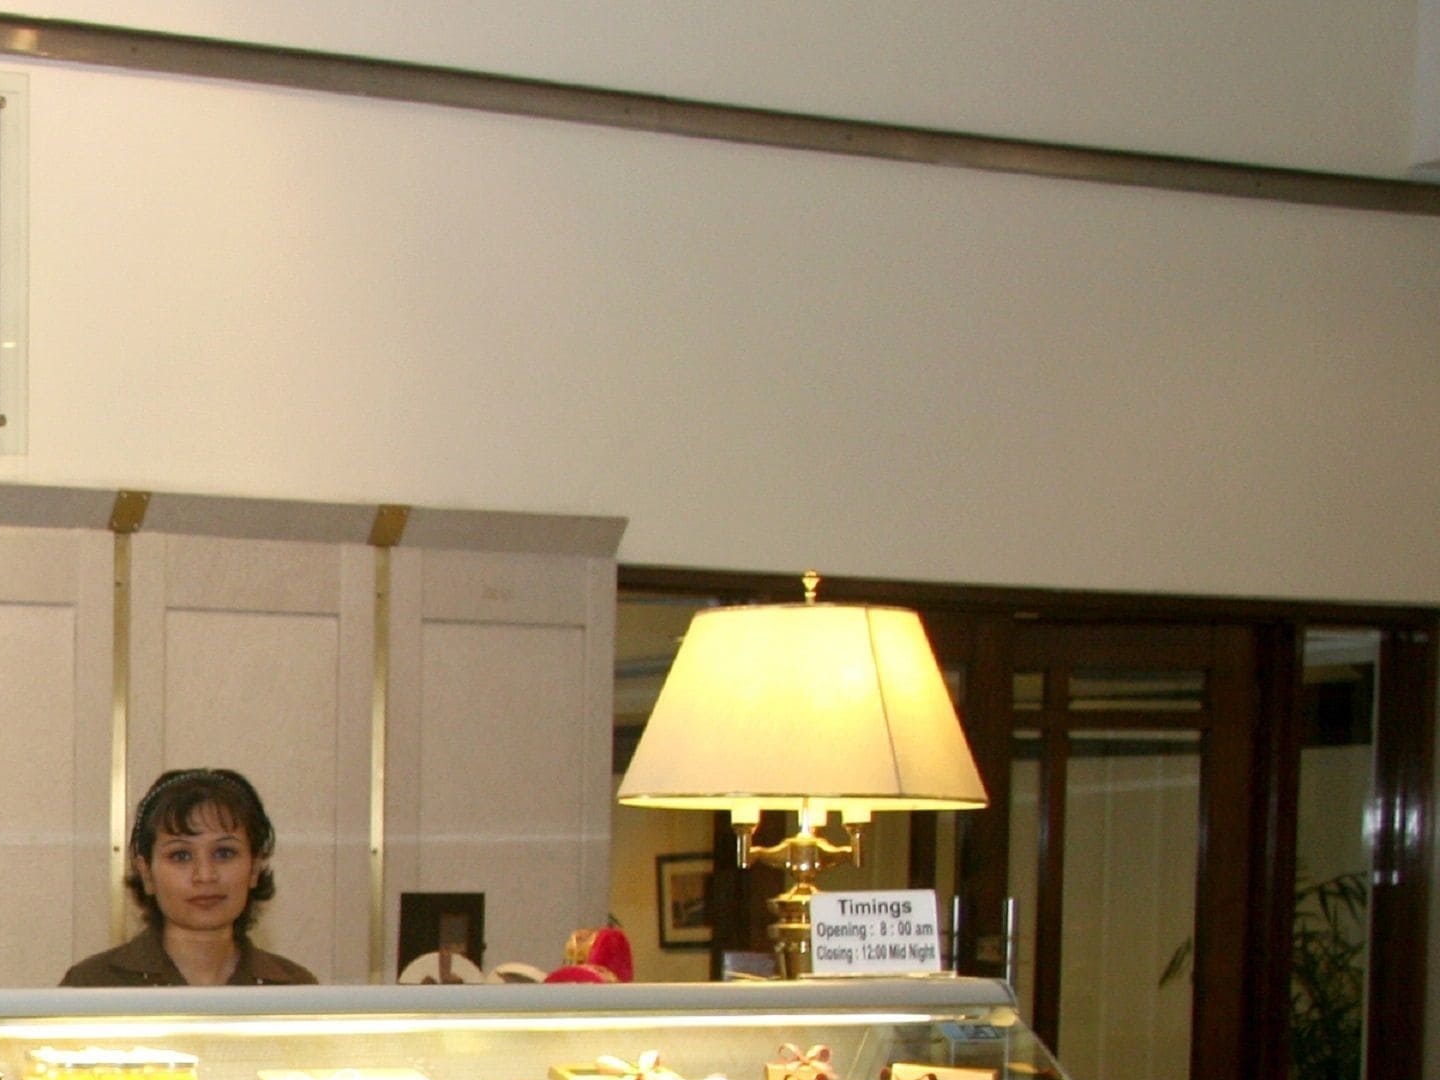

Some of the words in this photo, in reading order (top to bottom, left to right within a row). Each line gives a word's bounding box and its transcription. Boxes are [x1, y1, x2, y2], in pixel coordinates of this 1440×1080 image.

[837, 899, 913, 918] Timings
[915, 923, 934, 936] am
[889, 944, 907, 960] Mid
[909, 943, 935, 962] Night
